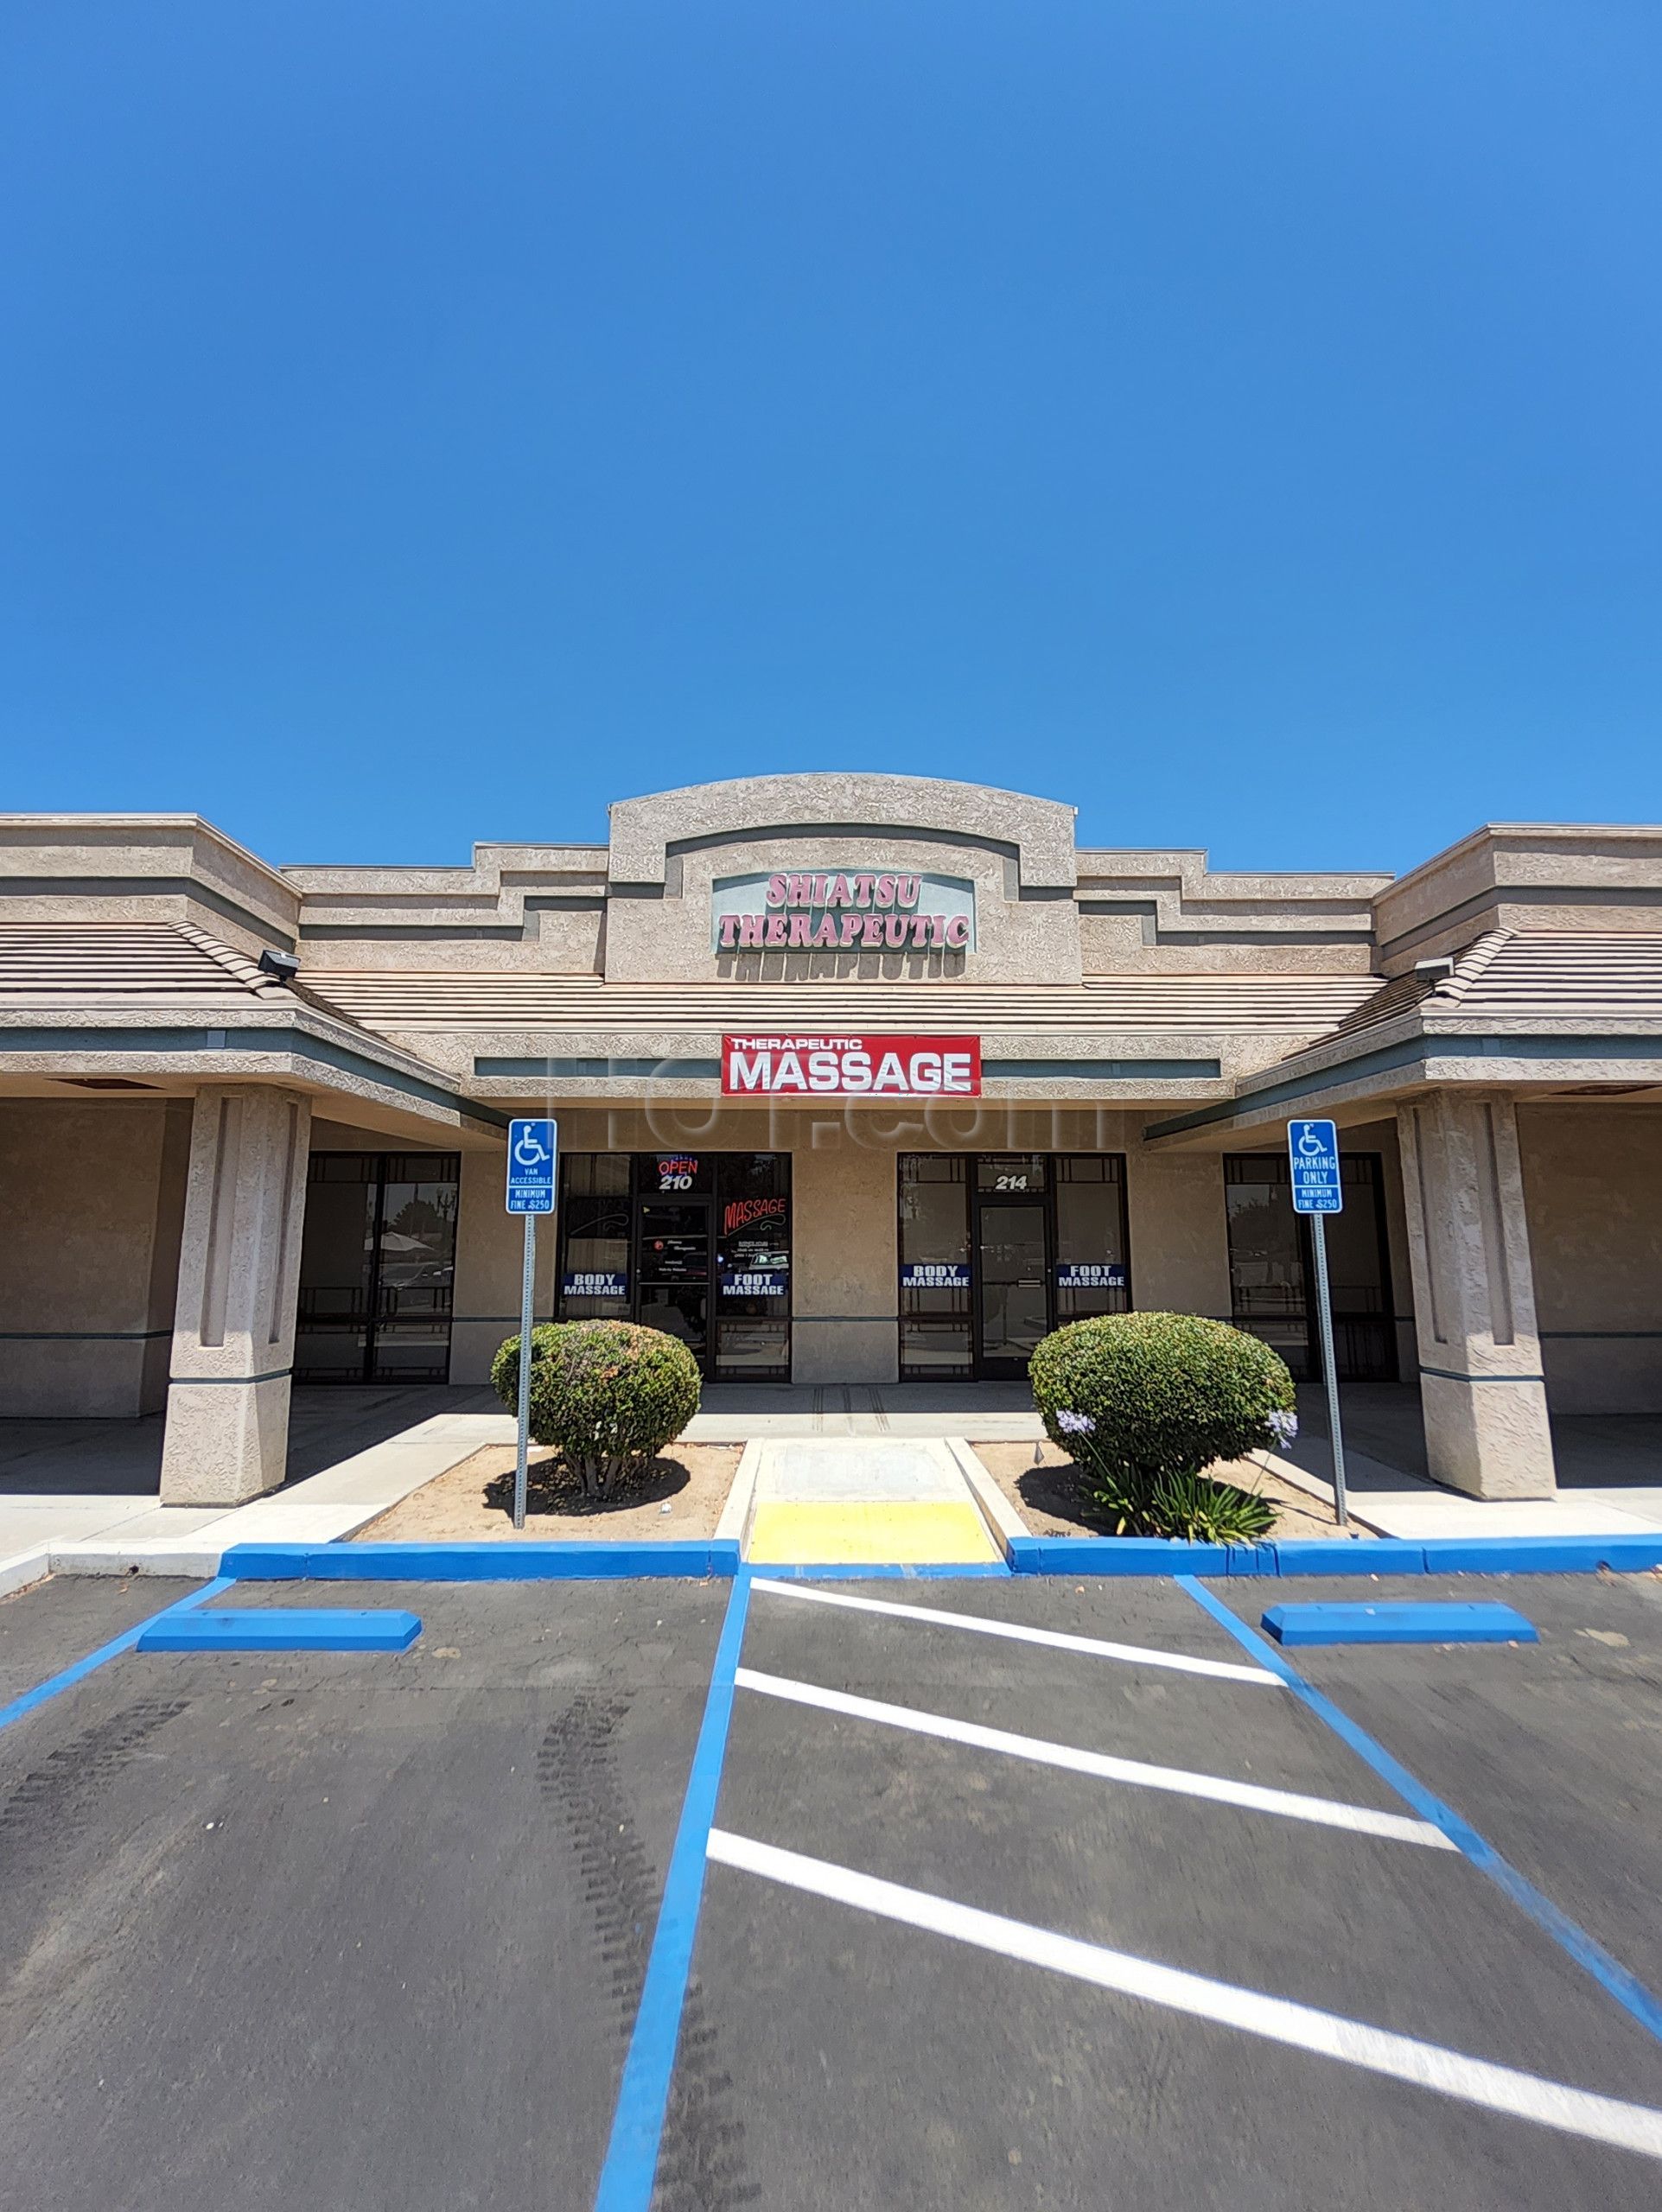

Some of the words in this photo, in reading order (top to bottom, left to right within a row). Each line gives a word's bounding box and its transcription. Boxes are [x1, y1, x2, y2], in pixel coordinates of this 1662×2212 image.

[766, 873, 922, 907] SHIATSU
[718, 913, 970, 948] THERAPEUTIC
[730, 1038, 863, 1050] THERAPEUTIC
[729, 1051, 971, 1091] MASSAGE
[659, 1160, 698, 1175] OPEN
[1294, 1157, 1336, 1170] PARKING
[659, 1175, 692, 1190] 210
[995, 1175, 1028, 1190] 214
[1303, 1171, 1328, 1184] ONLY
[515, 1190, 545, 1198] MINIMUM
[1302, 1189, 1332, 1198] MINIMUM
[510, 1200, 525, 1210] FINE
[1298, 1199, 1314, 1209] FINE
[724, 1198, 786, 1235] MASSAGE
[914, 1266, 958, 1277] BODY
[1070, 1265, 1111, 1277] FOOT
[574, 1274, 615, 1286] BODY
[734, 1274, 773, 1286] FOOT
[903, 1277, 969, 1287] MASSAGE
[1059, 1276, 1124, 1287] MASSAGE
[564, 1286, 625, 1295] MASSAGE
[723, 1286, 784, 1295] MASSAGE
